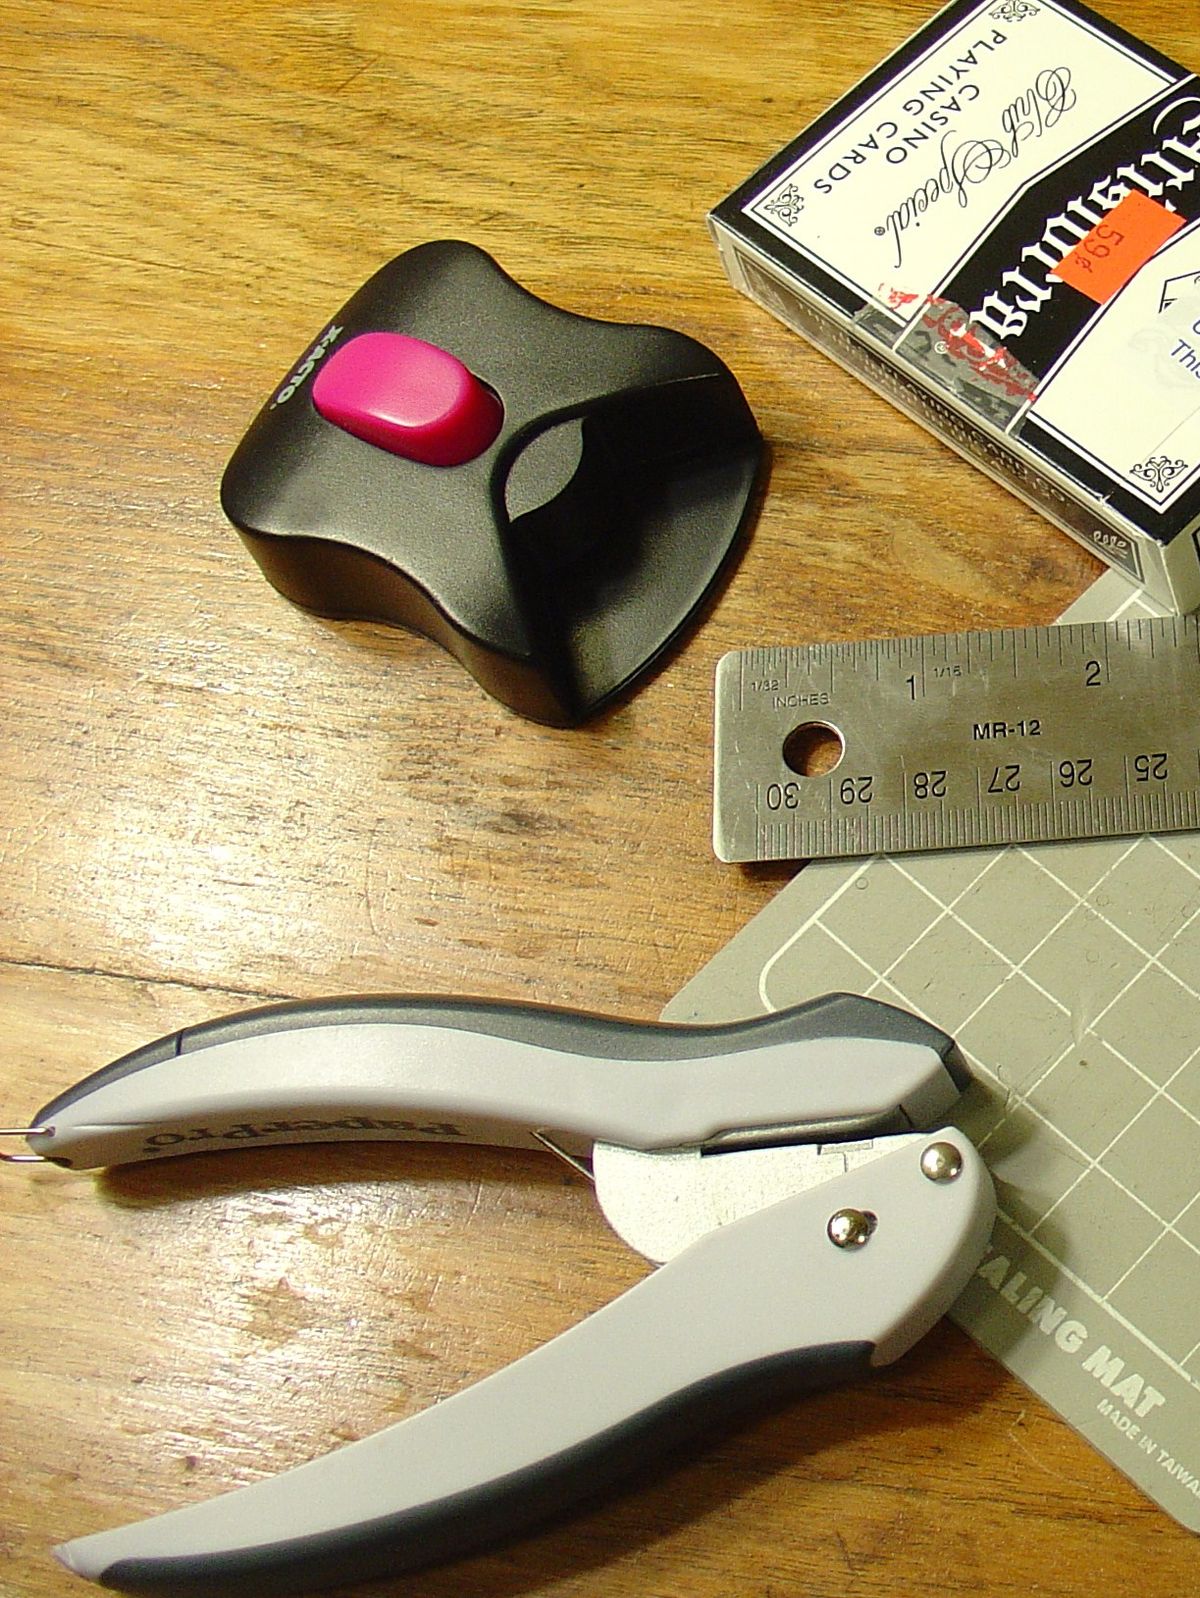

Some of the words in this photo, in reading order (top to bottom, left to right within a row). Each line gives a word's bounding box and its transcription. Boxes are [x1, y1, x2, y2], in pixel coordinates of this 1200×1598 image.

[903, 29, 1007, 116] PLAYING
[886, 85, 980, 164] CASINO
[1002, 67, 1076, 158] Club
[814, 121, 898, 194] CARDS
[886, 130, 1011, 268] Special
[751, 679, 779, 691] 1/32
[906, 675, 917, 700] 1
[1084, 660, 1102, 686] 2
[772, 692, 829, 708] INCHES
[973, 719, 1041, 740] MR-12
[987, 765, 1021, 794] 27
[1059, 759, 1093, 787] 26
[1134, 753, 1168, 782] 25
[767, 781, 800, 810] 30
[840, 776, 874, 804] 29
[914, 770, 947, 799] 28
[143, 1116, 467, 1147] PaperPro
[977, 1243, 1088, 1353] ALING
[1082, 1345, 1166, 1418] MAT
[1097, 1399, 1141, 1441] MADE
[1138, 1434, 1157, 1456] IN
